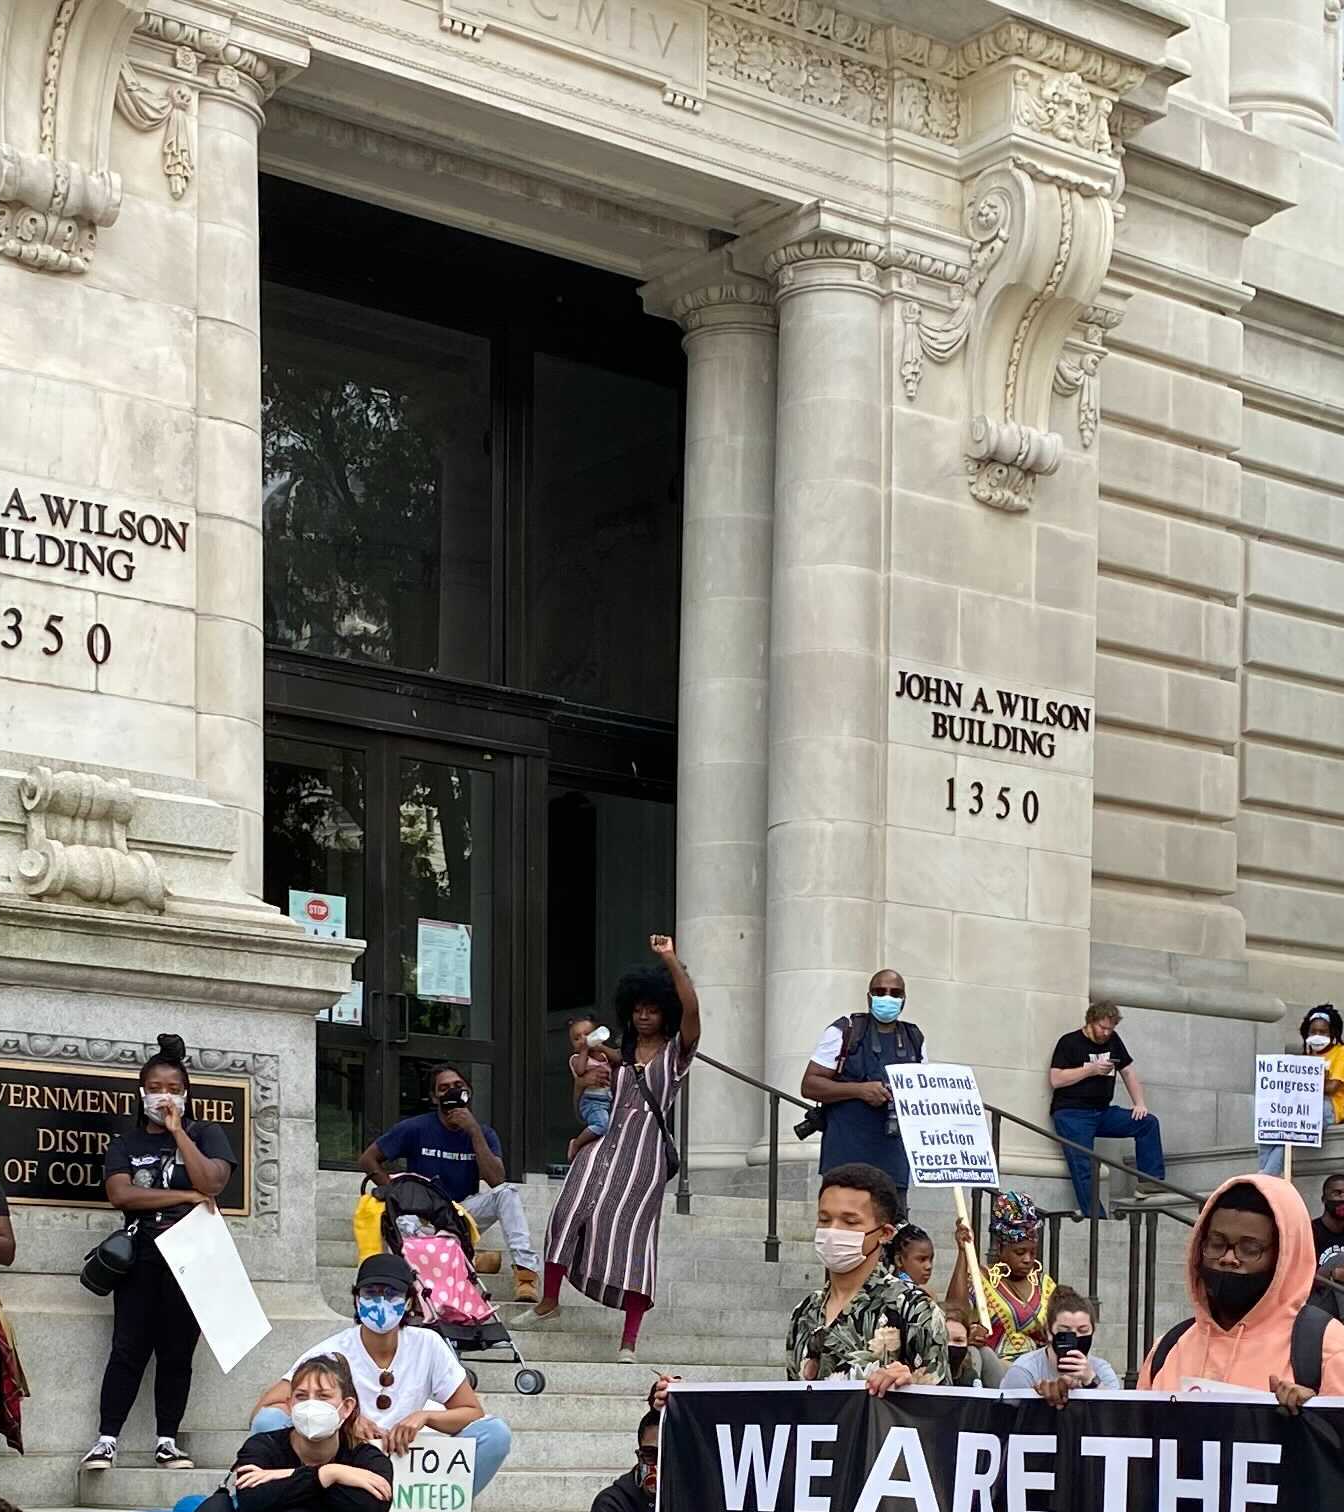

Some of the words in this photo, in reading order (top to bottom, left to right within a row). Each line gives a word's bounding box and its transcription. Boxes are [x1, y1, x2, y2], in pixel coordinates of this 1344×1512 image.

[0, 489, 37, 524] A.
[40, 493, 190, 553] WILSON
[896, 671, 963, 708] JOHN
[971, 688, 994, 714] A.
[996, 690, 1091, 732] WILSON
[931, 712, 1056, 759] BUILDING
[945, 777, 1040, 825] 1350
[308, 904, 329, 918] STOP
[1258, 1061, 1273, 1073] No
[1277, 1061, 1323, 1076] Excuses!
[892, 1074, 914, 1090] We
[918, 1074, 976, 1090] Demand:
[1260, 1077, 1319, 1094] Congress:
[190, 1099, 235, 1124] THE
[899, 1099, 982, 1116] Nationwide
[1270, 1103, 1293, 1115] Stop
[1296, 1104, 1310, 1116] All
[1258, 1118, 1298, 1129] Evictions
[36, 1128, 120, 1155] DISTR
[920, 1128, 975, 1146] Eviction
[912, 1150, 958, 1167] Freeze
[960, 1150, 992, 1167] Now!
[4, 1158, 39, 1183] OF
[407, 1446, 440, 1474] TO
[446, 1448, 472, 1474] A
